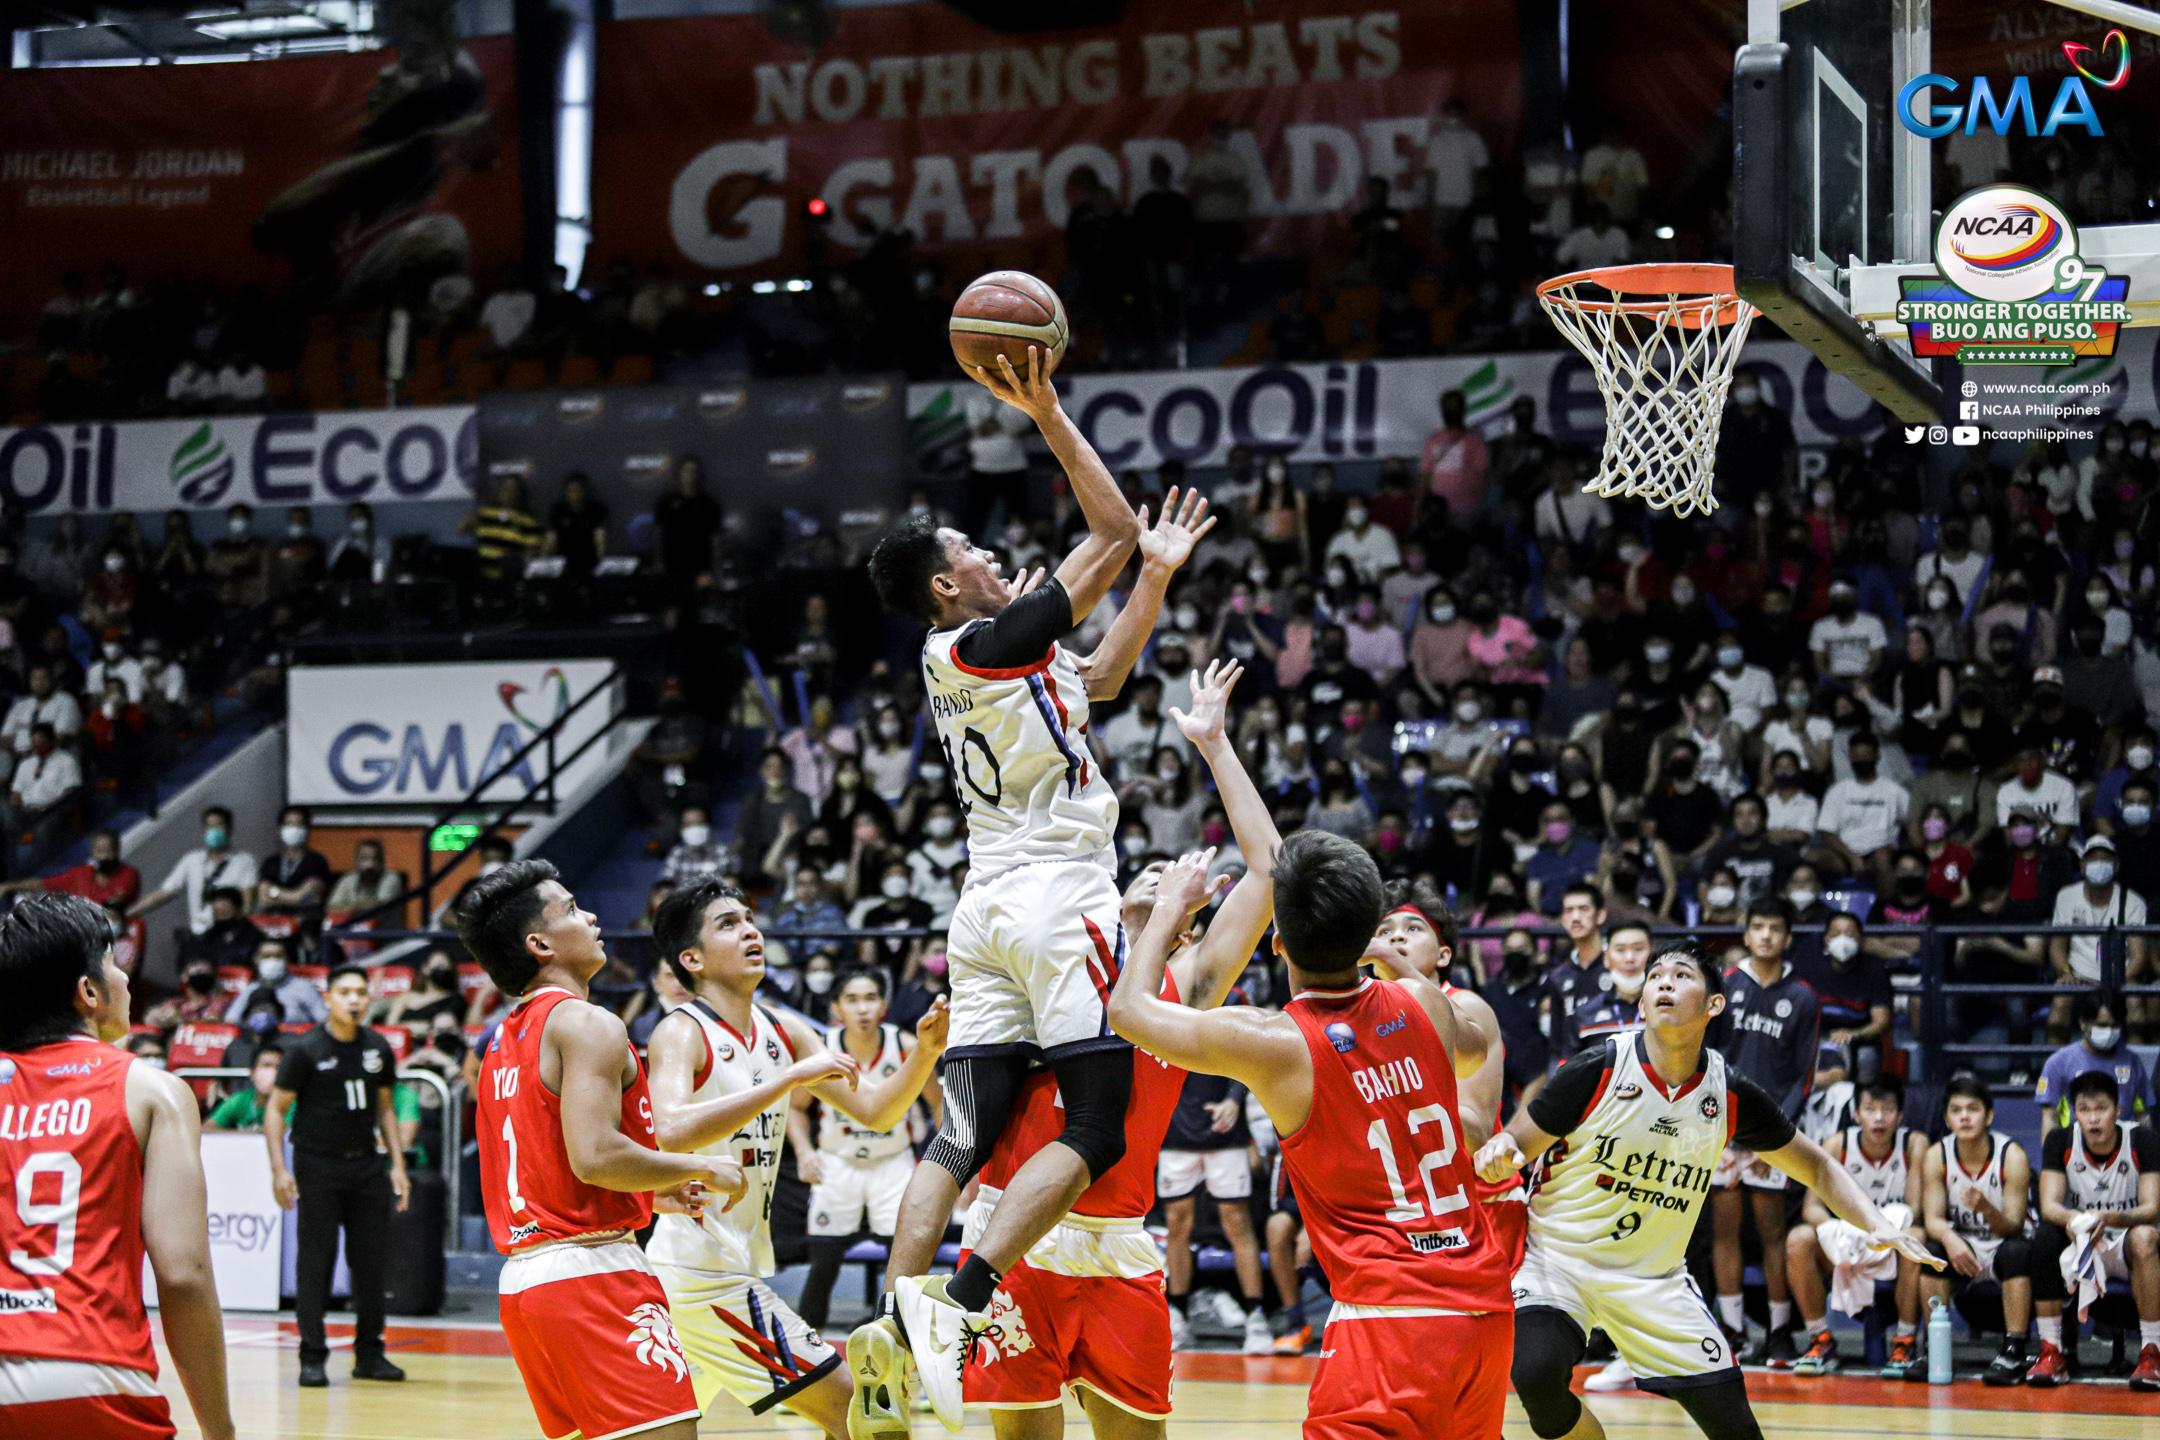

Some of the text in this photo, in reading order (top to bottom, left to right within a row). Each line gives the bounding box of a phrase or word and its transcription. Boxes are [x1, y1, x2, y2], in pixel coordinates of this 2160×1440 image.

[754, 12, 1399, 125] NOTHING BEATS
[668, 137, 788, 269] G
[1056, 364, 1377, 463] coOil
[328, 722, 539, 796] GMA
[1376, 1018, 1406, 1037] GMA
[47, 1063, 91, 1077] GMA
[344, 1079, 367, 1110] 11
[1352, 1056, 1423, 1104] BAHIO
[0, 1097, 92, 1141] LLEGO
[502, 1114, 526, 1214] 1
[1367, 1103, 1470, 1222] 12
[1590, 1135, 1712, 1193] Letran
[8, 1151, 82, 1275] 9
[1614, 1181, 1690, 1213] PETRON
[1610, 1211, 1642, 1241] 9
[1701, 1336, 1721, 1363] 9
